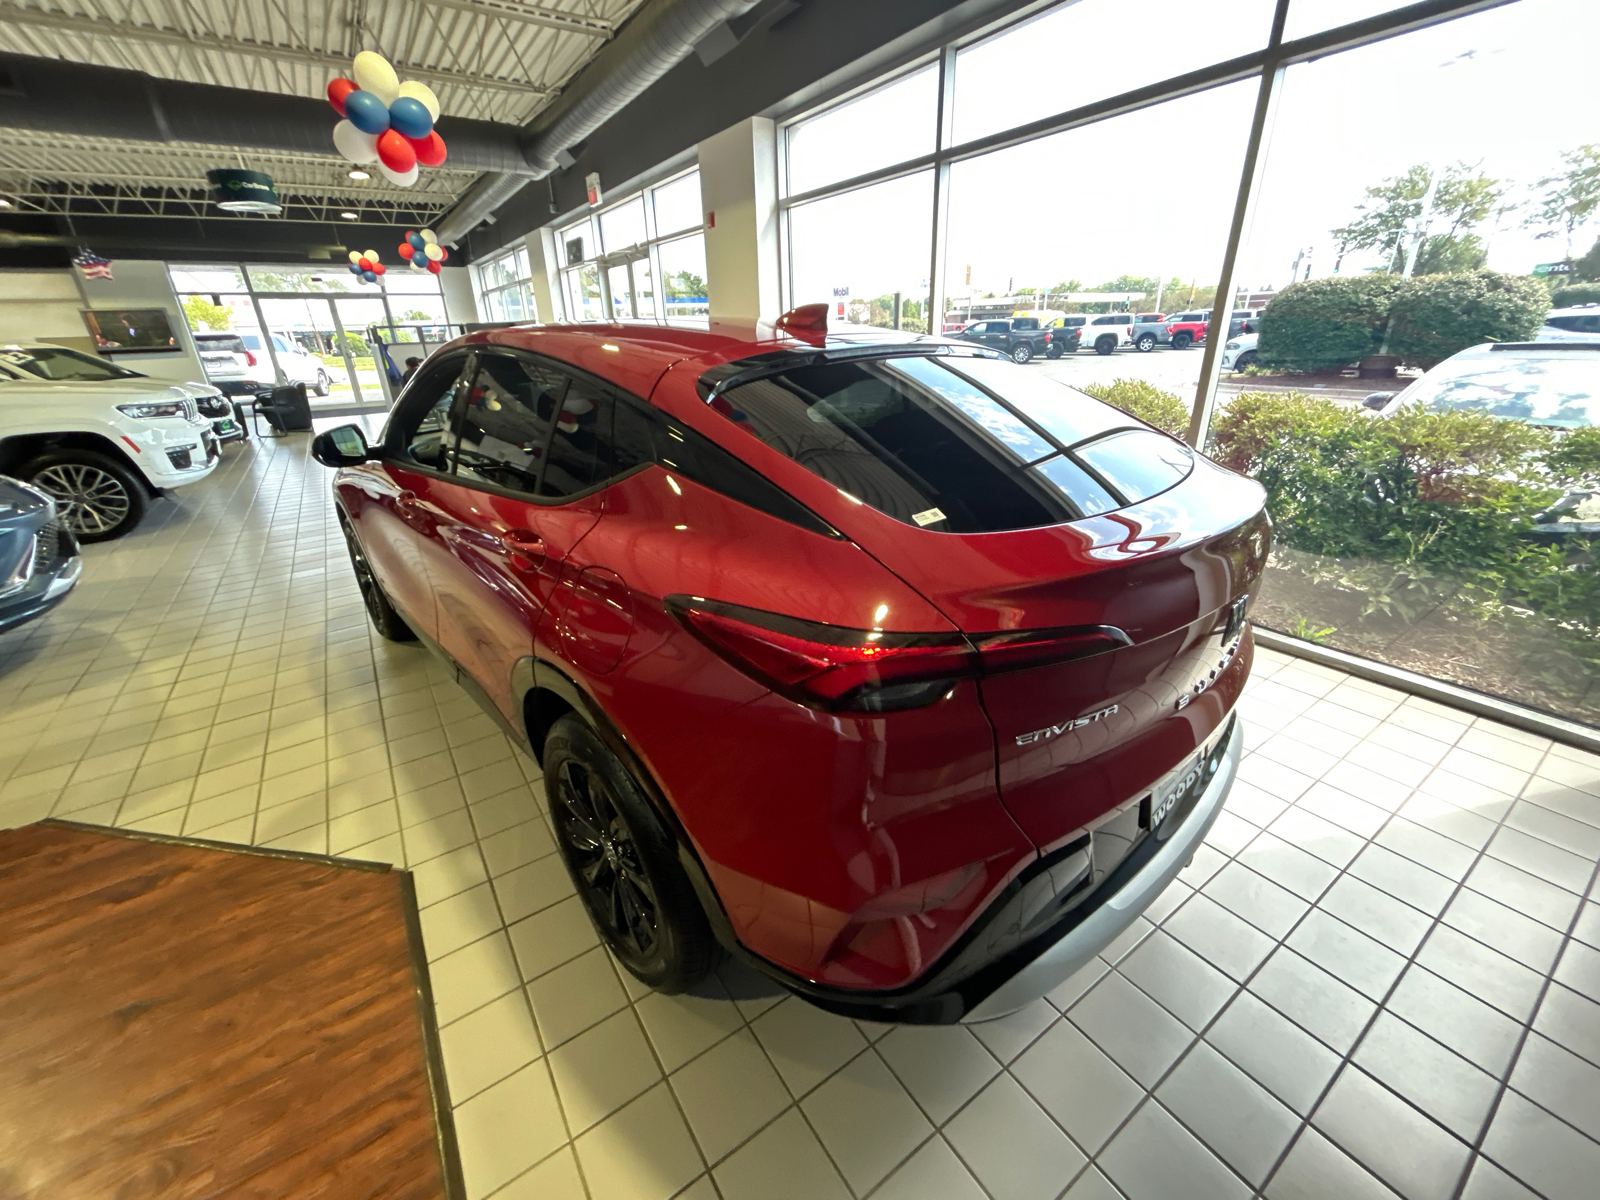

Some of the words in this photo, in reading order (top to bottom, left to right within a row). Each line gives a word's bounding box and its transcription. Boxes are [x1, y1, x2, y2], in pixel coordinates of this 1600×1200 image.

[833, 287, 849, 297] Mobil
[1015, 704, 1119, 746] ENVISTA
[1152, 759, 1206, 826] WOODY
